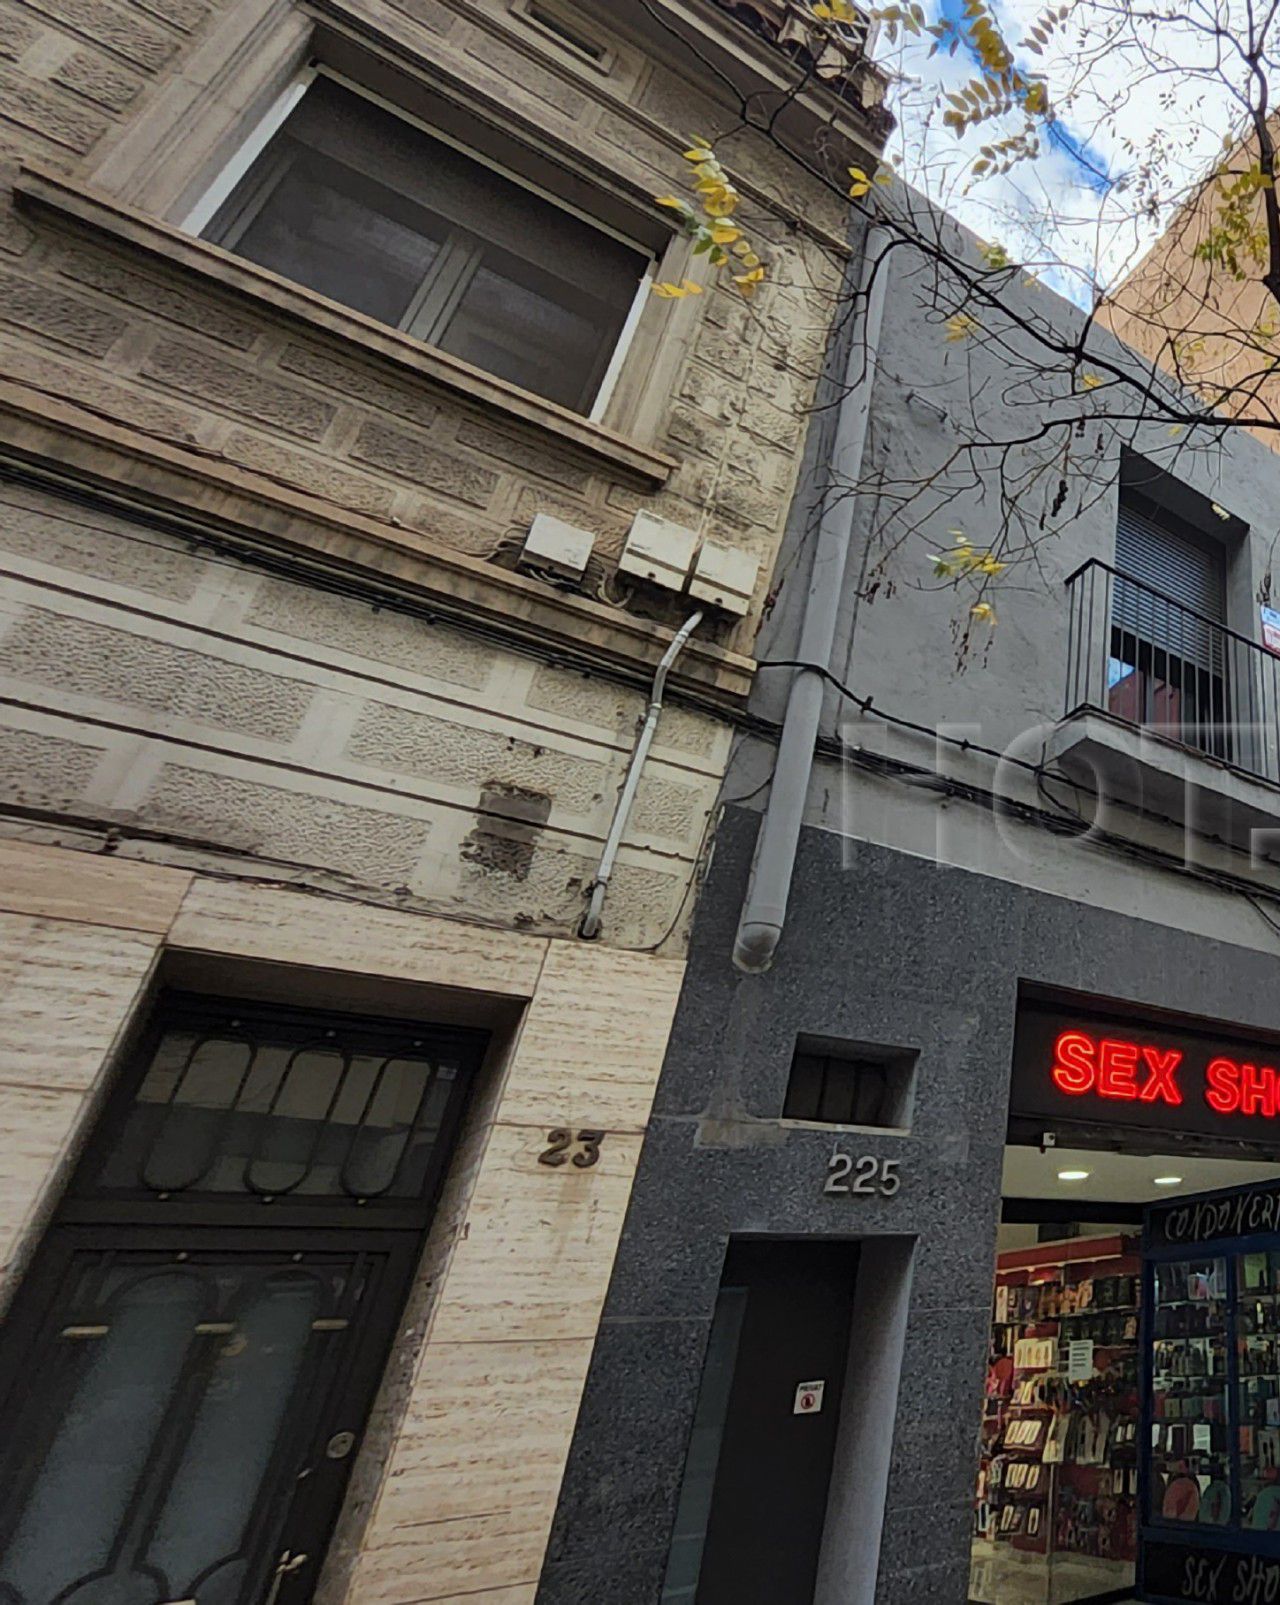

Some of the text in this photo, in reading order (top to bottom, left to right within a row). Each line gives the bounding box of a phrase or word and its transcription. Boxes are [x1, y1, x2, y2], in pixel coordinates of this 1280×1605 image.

[1054, 1033, 1183, 1105] SEX
[538, 1127, 605, 1168] 23
[824, 1153, 900, 1195] 225
[1183, 1555, 1227, 1600] SEX
